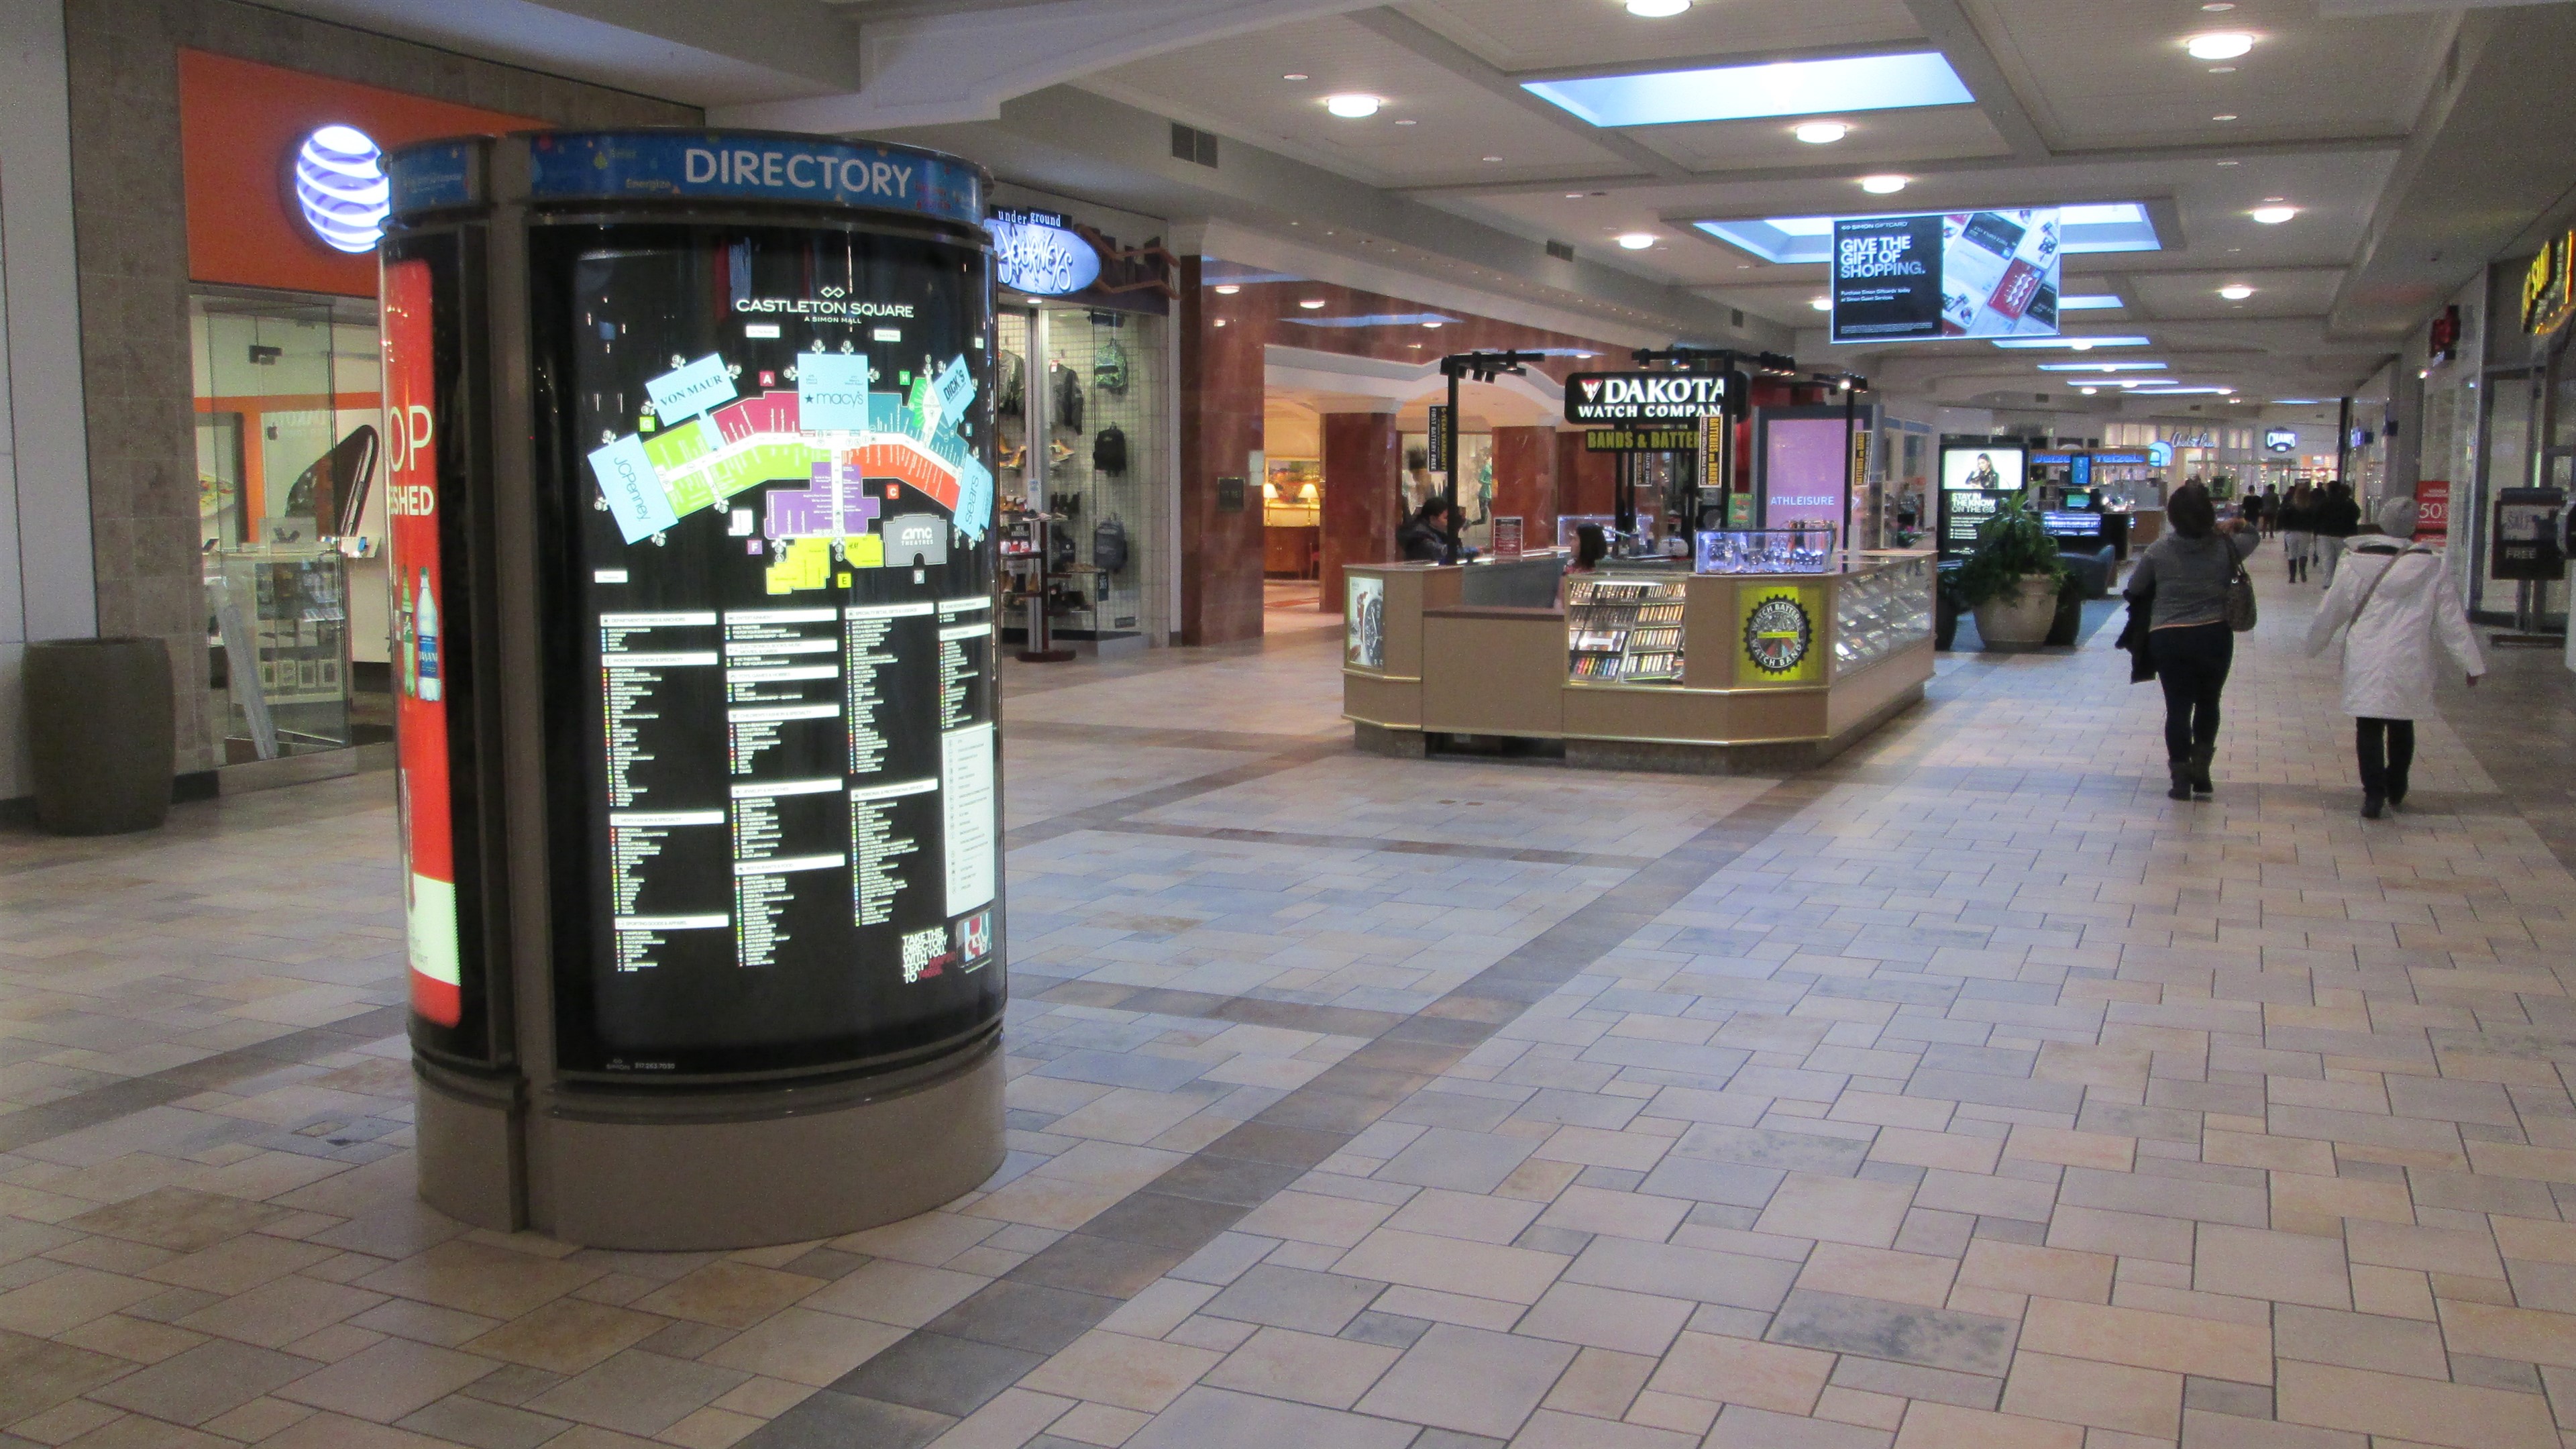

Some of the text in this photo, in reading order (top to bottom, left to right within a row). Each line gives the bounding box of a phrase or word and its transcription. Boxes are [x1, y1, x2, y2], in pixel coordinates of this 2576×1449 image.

[685, 149, 912, 198] DIRECTORY
[998, 210, 1061, 227] under ground
[1841, 235, 1911, 252] GIVE THE
[1841, 250, 1902, 265] GIFT OF
[1841, 262, 1926, 278] SHOPPING.
[736, 299, 914, 318] CASTLETON SQUARE
[763, 375, 771, 384] A
[902, 374, 908, 382] H
[943, 370, 966, 402] DICK'S
[660, 374, 724, 407] VON MAUR
[1604, 378, 1725, 404] DAKOTA
[817, 390, 863, 409] macy's
[1578, 405, 1721, 418] WATCH COMPAN
[643, 420, 651, 429] G
[1587, 431, 1633, 449] BANDS
[1638, 433, 1647, 449] &
[1709, 418, 1719, 452] BATTERIES
[1708, 462, 1718, 485] BANDS
[614, 457, 651, 521] JCPenney
[890, 488, 897, 496] C
[1952, 492, 1972, 500] STAY
[966, 476, 979, 525] sears
[1770, 496, 1835, 506] ATHLEISURE
[902, 527, 932, 541] amc
[752, 543, 758, 552] F
[842, 576, 847, 585] E
[917, 572, 923, 582] D
[1752, 606, 1772, 631] WATCH
[1751, 639, 1776, 666] WATCH
[902, 926, 945, 947] TAKE THIS
[903, 934, 948, 955] DIRECTORY
[903, 951, 927, 965] WITH
[928, 945, 947, 959] YOU.
[904, 972, 918, 984] TO
